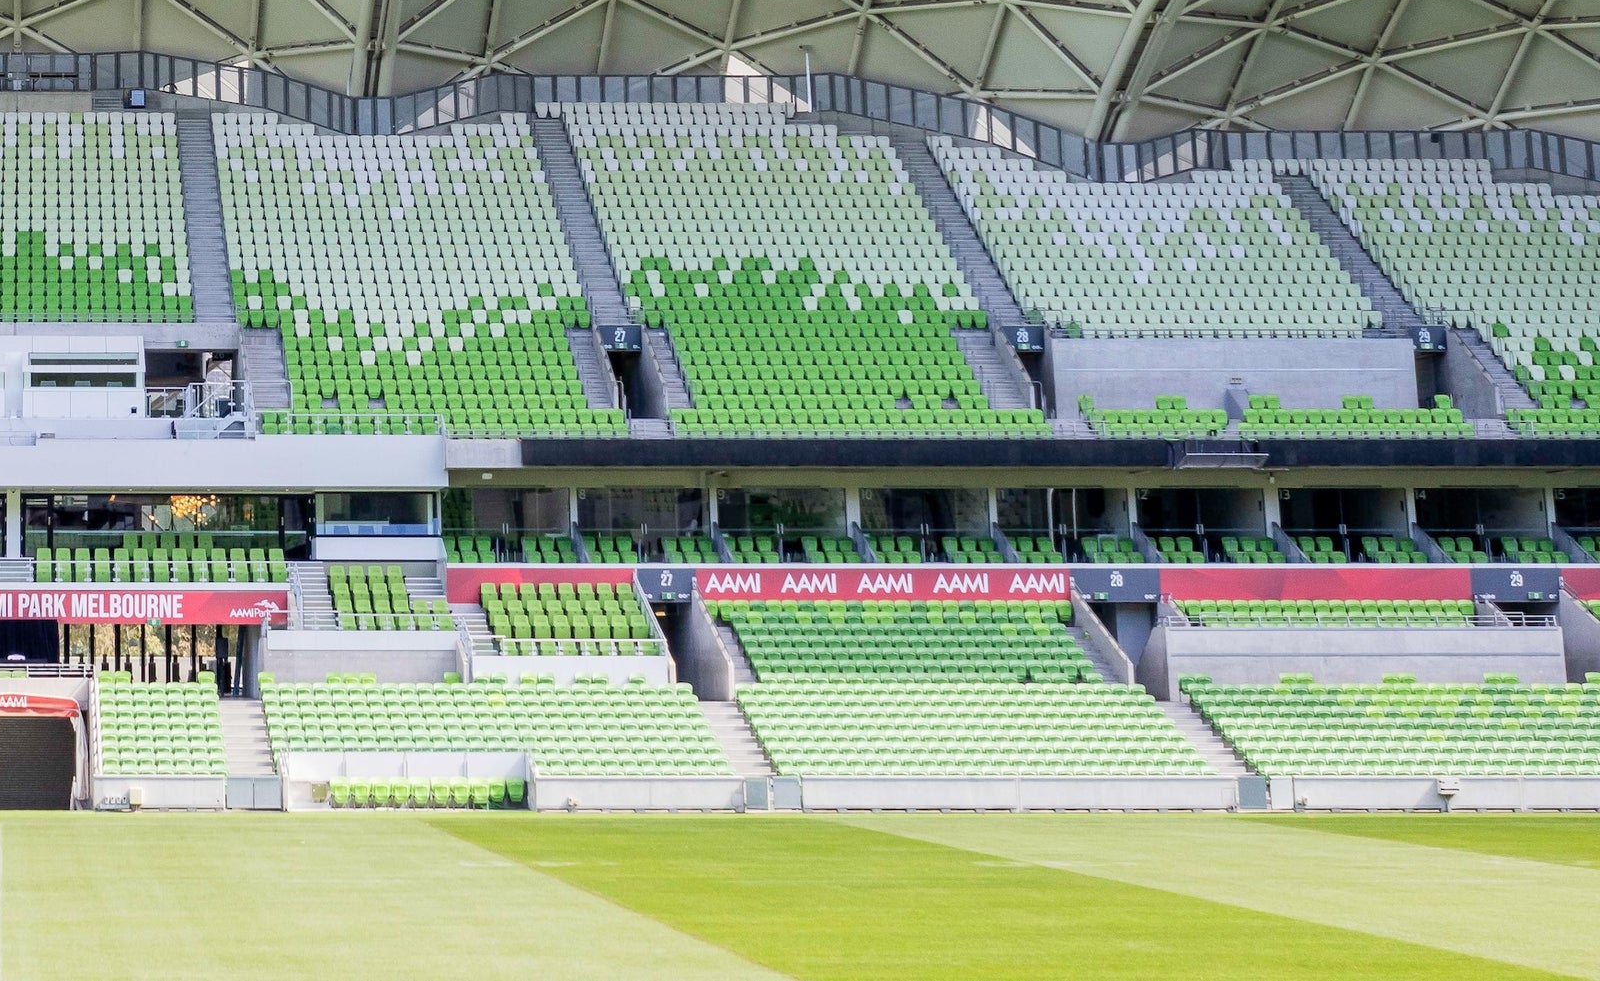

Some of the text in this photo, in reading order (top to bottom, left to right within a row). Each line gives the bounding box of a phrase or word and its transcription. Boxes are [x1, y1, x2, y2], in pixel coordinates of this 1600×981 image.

[614, 330, 626, 342] 27
[1016, 331, 1029, 343] 28
[1418, 331, 1431, 343] 29
[660, 573, 673, 586] 27
[704, 573, 761, 593] AAMI
[780, 573, 837, 593] AAMI
[856, 573, 913, 593] AAMI
[932, 573, 989, 593] AAMI
[1008, 573, 1065, 593] AAMI
[1110, 574, 1123, 587] 28
[1510, 574, 1523, 587] 29
[18, 593, 67, 618] PARK
[71, 594, 184, 618] MELBOURNE
